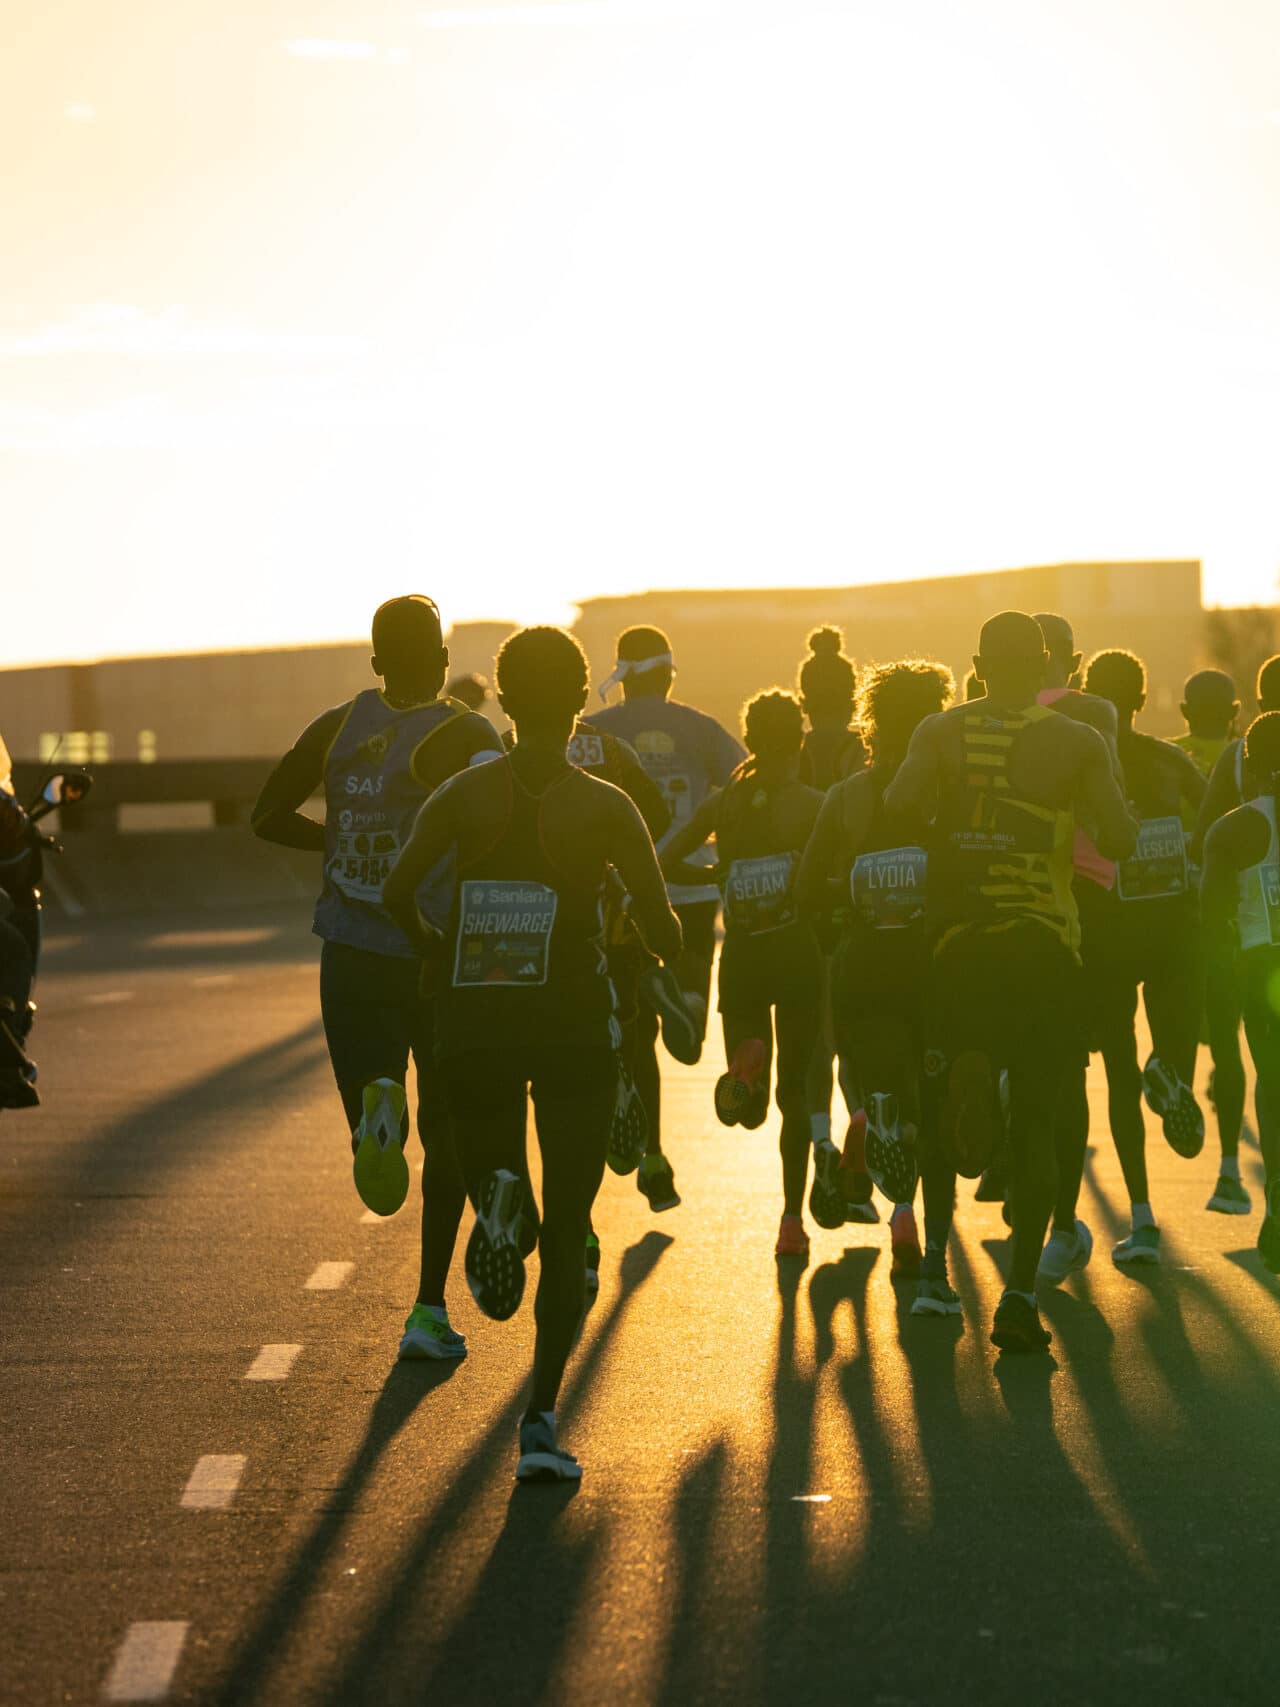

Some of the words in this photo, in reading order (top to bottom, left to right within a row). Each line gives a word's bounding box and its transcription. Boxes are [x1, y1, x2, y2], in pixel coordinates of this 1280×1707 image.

[572, 736, 601, 763] 35
[733, 872, 787, 901] SELAM
[868, 864, 917, 889] LYDIA
[488, 887, 550, 904] Sanlam
[464, 911, 552, 935] SHEWARGE
